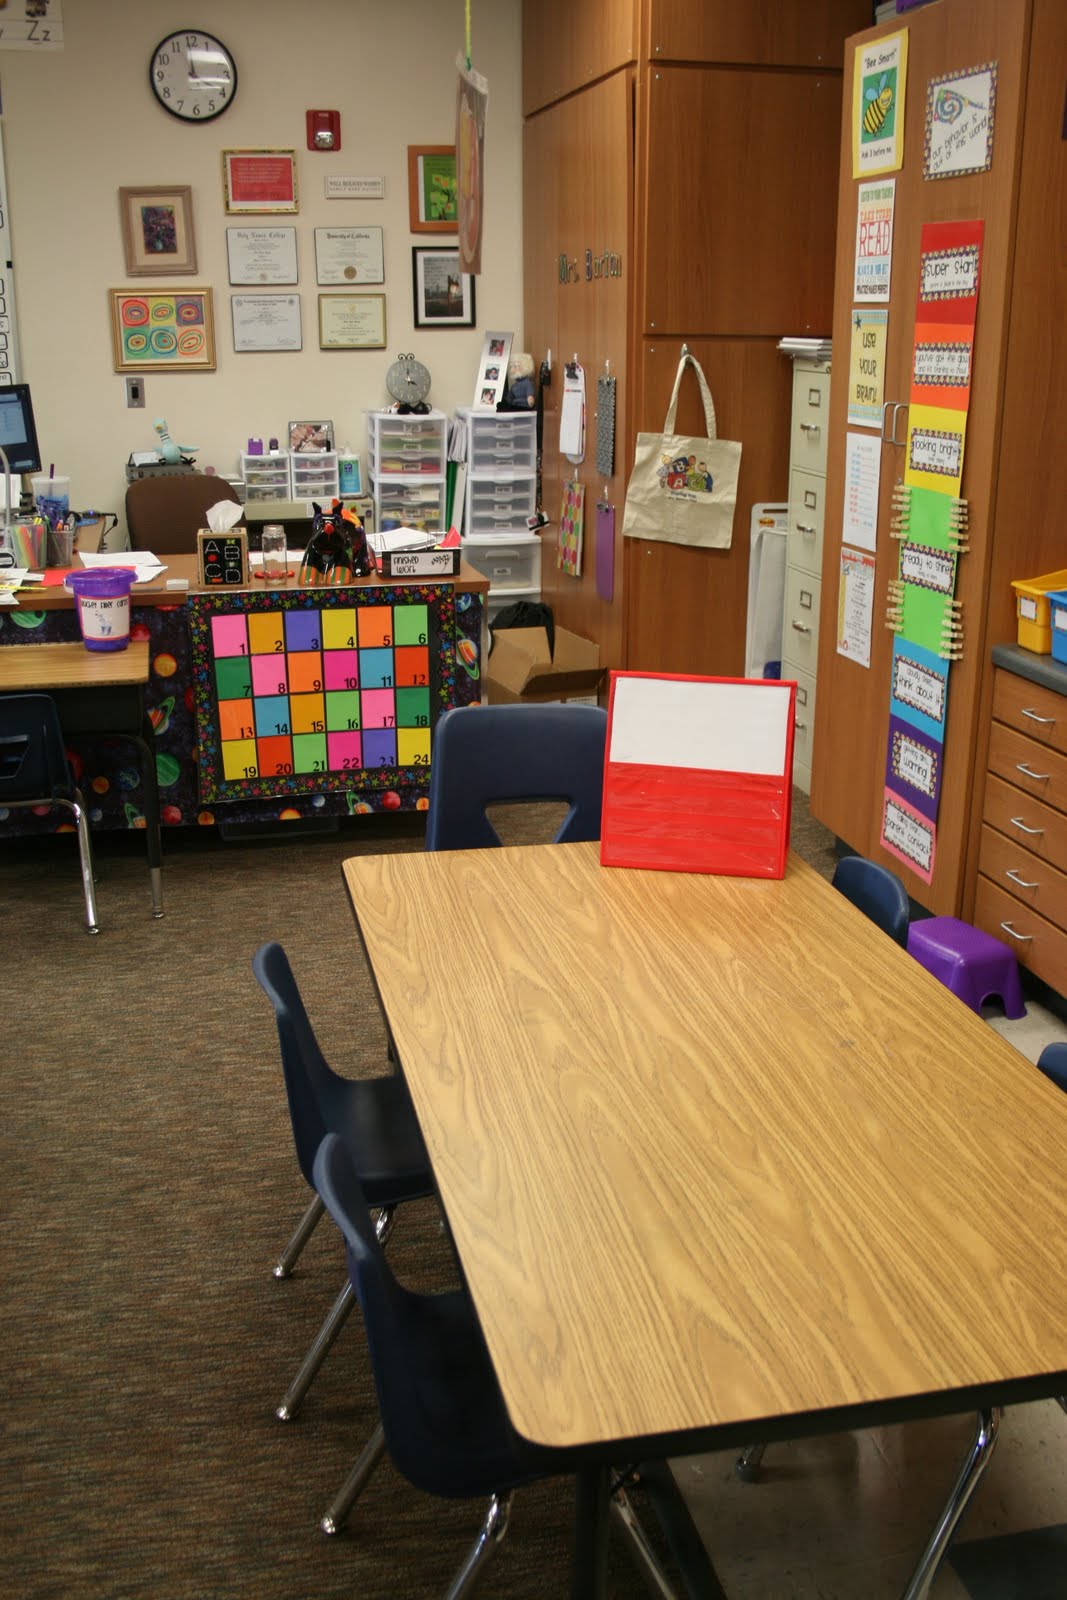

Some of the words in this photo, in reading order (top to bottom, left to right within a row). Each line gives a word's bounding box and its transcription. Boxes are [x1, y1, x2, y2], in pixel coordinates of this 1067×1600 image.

[171, 41, 180, 53] 11
[185, 35, 198, 48] 12
[158, 53, 170, 66] 10
[156, 70, 164, 81] 9
[163, 86, 171, 98] 8
[219, 87, 226, 98] 4
[176, 100, 184, 112] 7
[192, 104, 200, 116] 6
[208, 100, 215, 112] 5
[944, 120, 969, 149] behavior
[859, 219, 891, 257] READ
[925, 262, 950, 279] super
[859, 358, 877, 378] YOUR
[674, 478, 683, 488] A
[205, 540, 220, 554] A
[224, 545, 240, 560] B
[904, 554, 923, 571] ready
[204, 563, 222, 578] C
[225, 568, 241, 583] D
[239, 643, 246, 655] 1
[274, 640, 283, 652] 2
[311, 638, 319, 650] 3
[347, 636, 355, 648] 4
[383, 635, 391, 646] 5
[418, 633, 426, 644] 6
[242, 685, 250, 697] 7
[278, 683, 286, 694] 8
[313, 680, 321, 691] 9
[344, 677, 357, 688] 10
[381, 676, 392, 687] 11
[413, 674, 426, 685] 12
[240, 727, 253, 738] 13
[275, 723, 288, 735] 14
[311, 721, 324, 732] 15
[347, 718, 359, 730] 16
[382, 716, 395, 727] 17
[414, 715, 428, 726] 18
[242, 766, 257, 778] 19
[275, 763, 292, 775] 20
[313, 760, 325, 772] 21
[342, 758, 359, 769] 22
[379, 756, 394, 768] 23
[413, 754, 429, 766] 24
